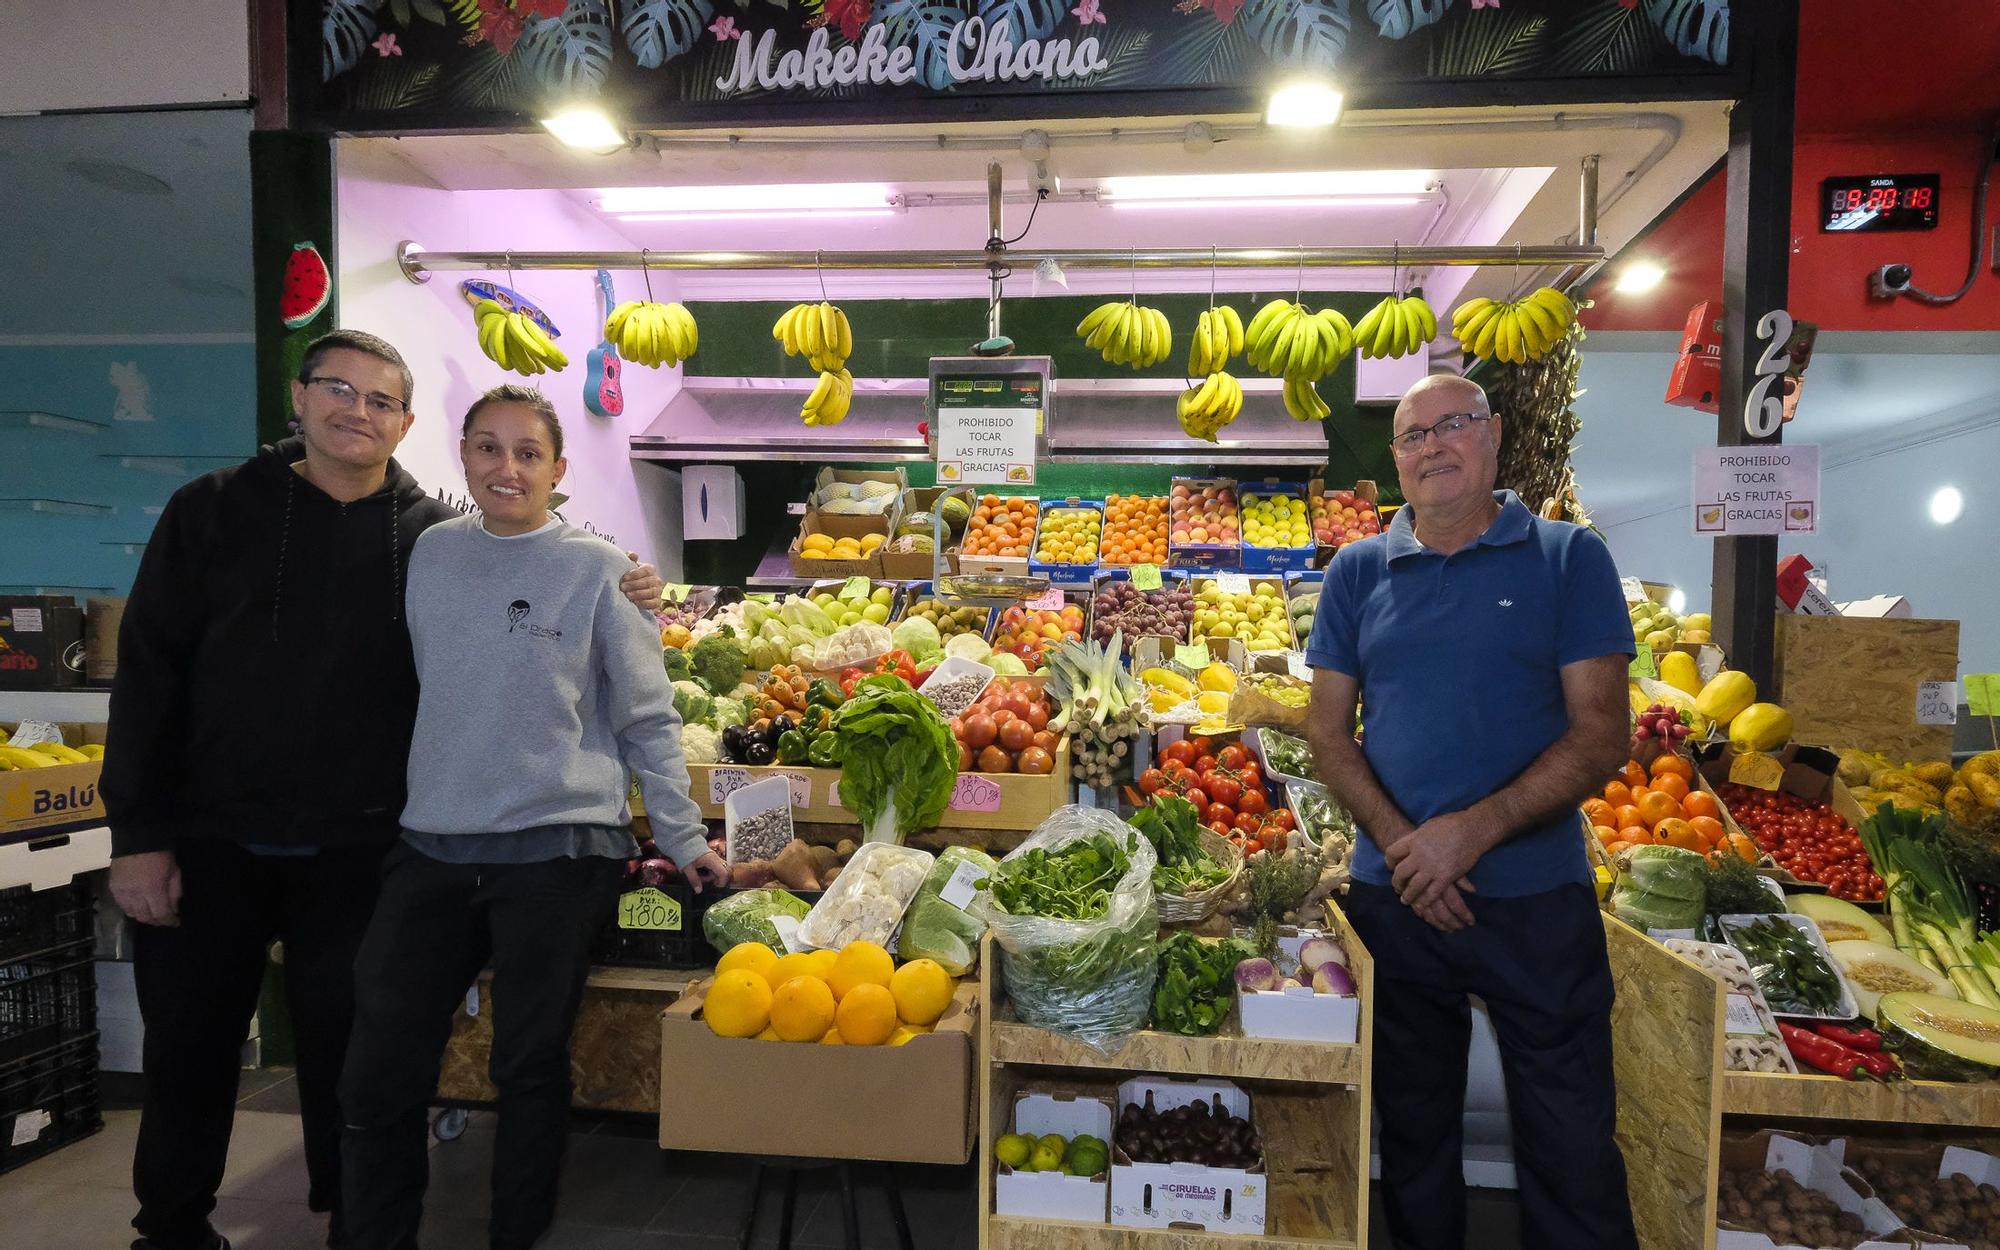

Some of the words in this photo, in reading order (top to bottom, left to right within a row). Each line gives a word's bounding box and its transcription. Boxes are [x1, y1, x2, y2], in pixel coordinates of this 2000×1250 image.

[1870, 179, 1894, 187] SANDA
[958, 418, 1014, 427] PROHIBIDO
[969, 432, 1002, 441] TOCAR
[956, 447, 974, 457] LAS
[976, 447, 1014, 457] FRUTAS
[1720, 455, 1791, 467] PROHIBIDO
[963, 463, 1006, 472] GRACIAS
[1735, 472, 1776, 483] TOCAR
[1717, 491, 1741, 502] LAS
[1745, 490, 1793, 501] FRUTAS
[1726, 509, 1783, 520] GRACIAS
[34, 783, 95, 815] Balú
[1168, 1183, 1217, 1195] CIRUELAS
